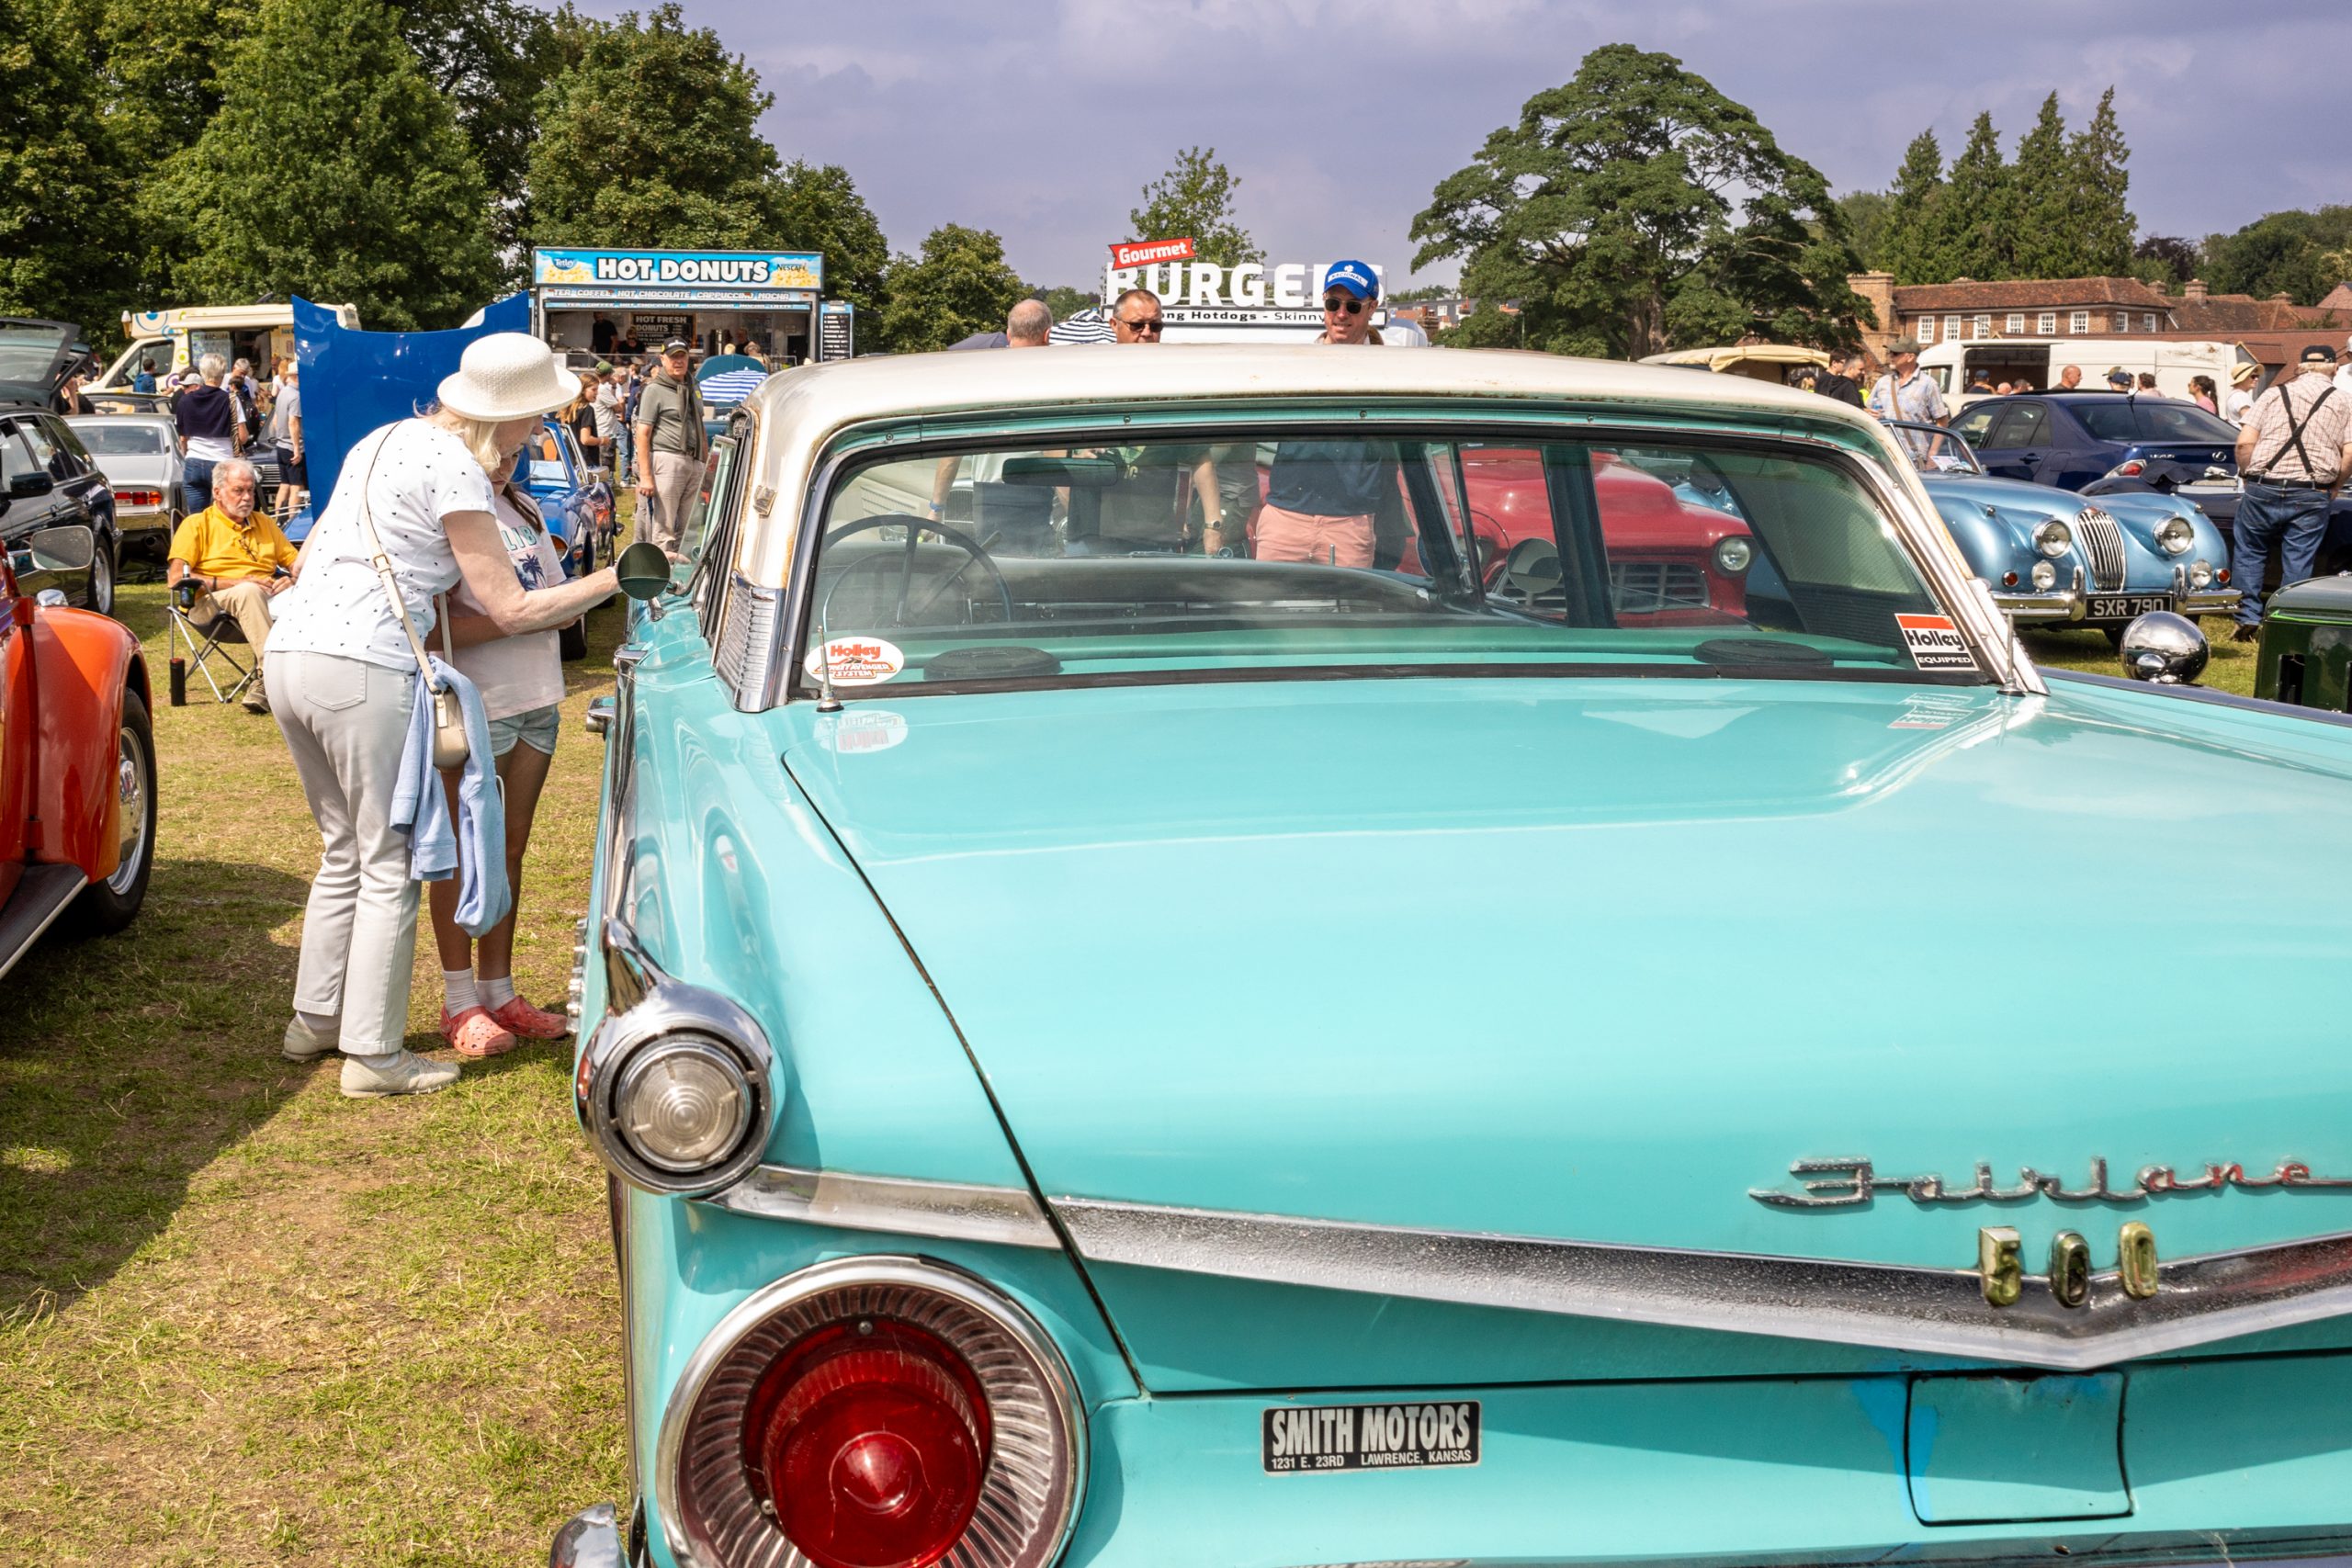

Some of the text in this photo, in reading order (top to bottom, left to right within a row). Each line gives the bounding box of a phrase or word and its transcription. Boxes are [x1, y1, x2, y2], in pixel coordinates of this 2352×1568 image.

[554, 258, 575, 268] Tetley
[1118, 242, 1189, 265] Gourmet
[596, 257, 770, 283] HOT DONUTS
[1192, 311, 1257, 321] Hotdogs
[2094, 600, 2128, 616] SXR
[1904, 630, 1965, 651] Holley
[831, 644, 881, 660] Holley
[1917, 656, 1972, 664] EQUIPPED
[1978, 1221, 2158, 1308] 500
[1272, 1404, 1470, 1457] SMITH MOTORS
[1272, 1450, 1472, 1470] 1231 E. 23RD LAWRENCE, KANSAS
